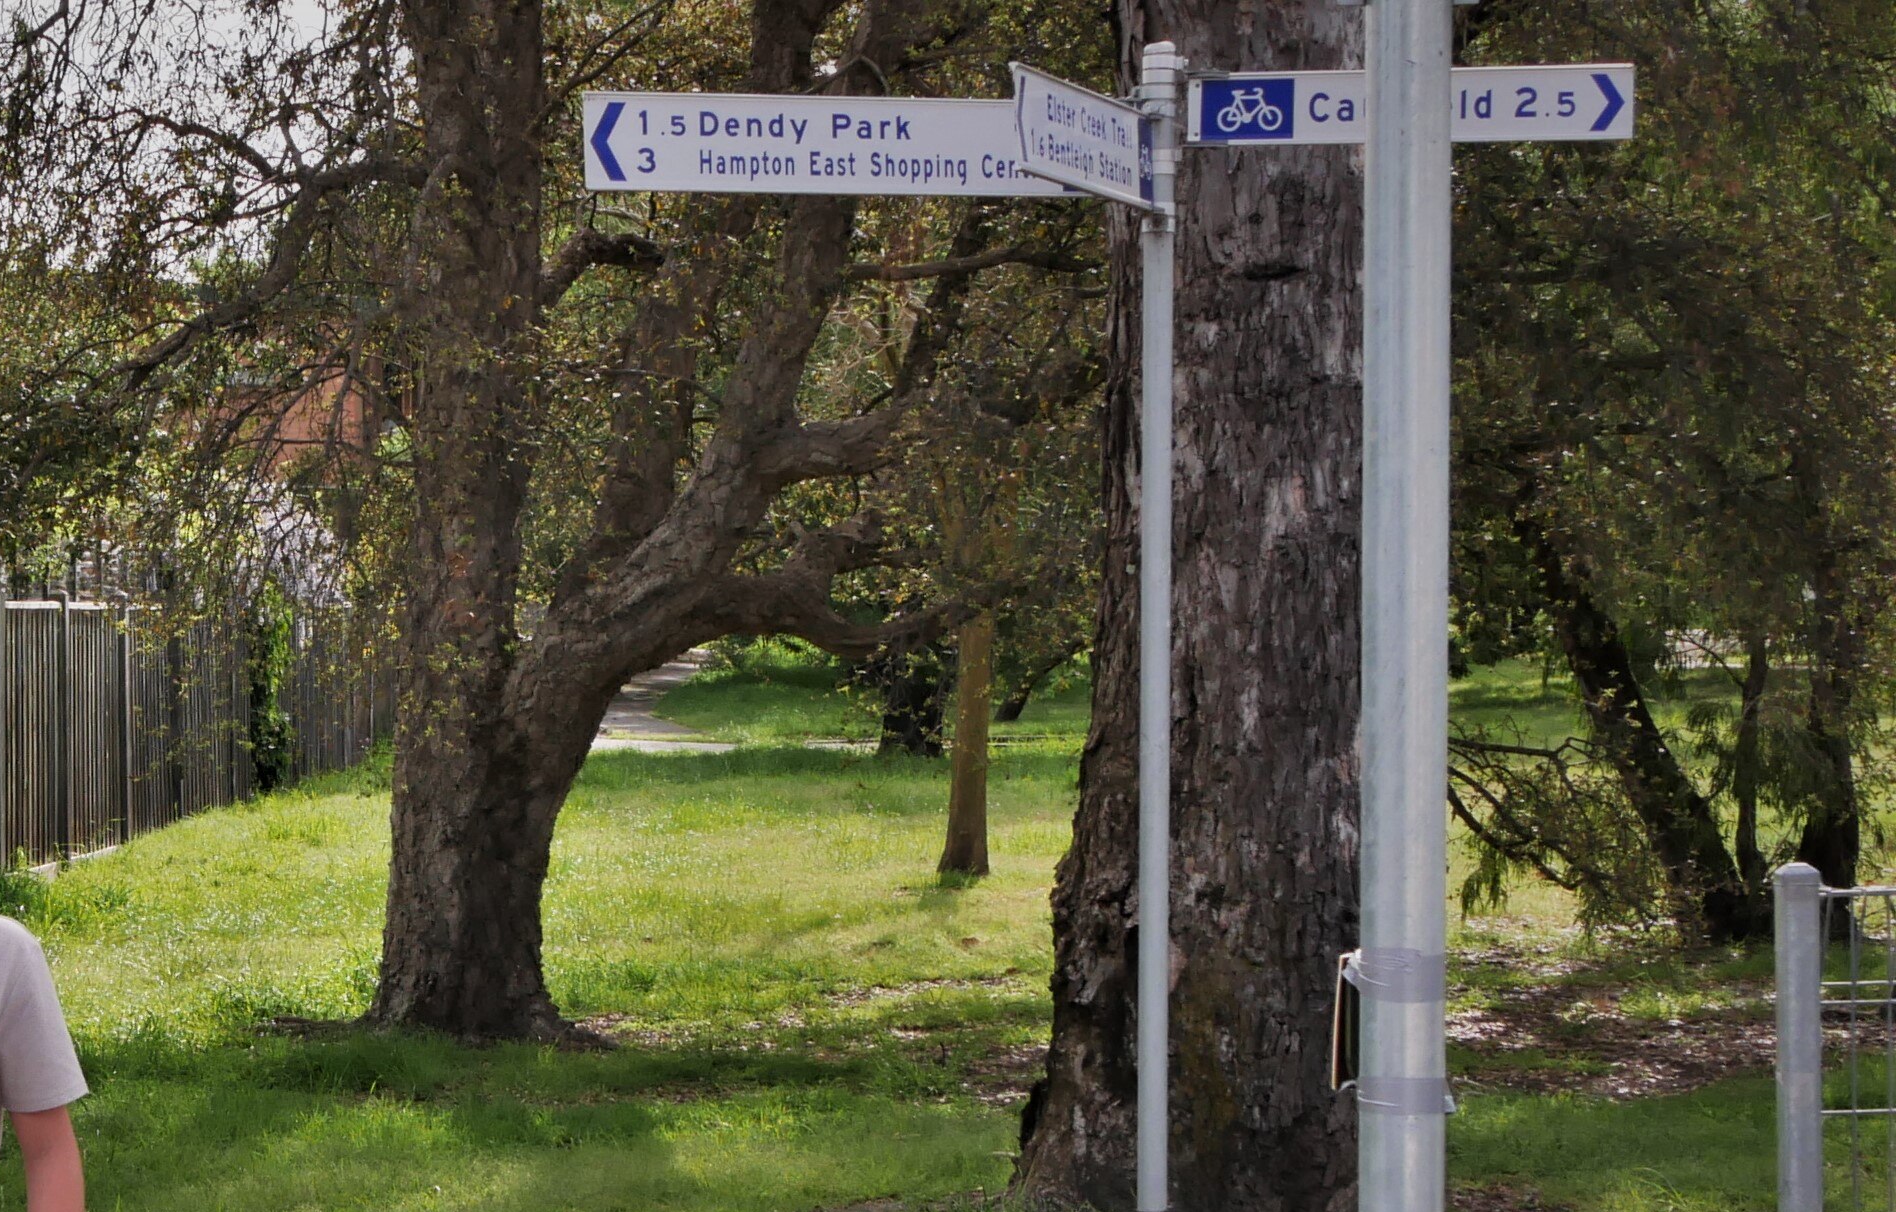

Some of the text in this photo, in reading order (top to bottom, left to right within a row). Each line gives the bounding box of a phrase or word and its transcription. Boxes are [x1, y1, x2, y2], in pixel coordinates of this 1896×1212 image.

[1047, 93, 1133, 150] Elster Creek Trail
[1514, 86, 1576, 118] 2.5
[638, 110, 911, 144] 1.5 Dendy Park
[636, 147, 656, 174] 3
[699, 149, 796, 181] Hampton
[809, 151, 856, 177] East
[870, 152, 967, 186] Shopping
[1031, 128, 1132, 187] 1.6 Bentleigh Station
